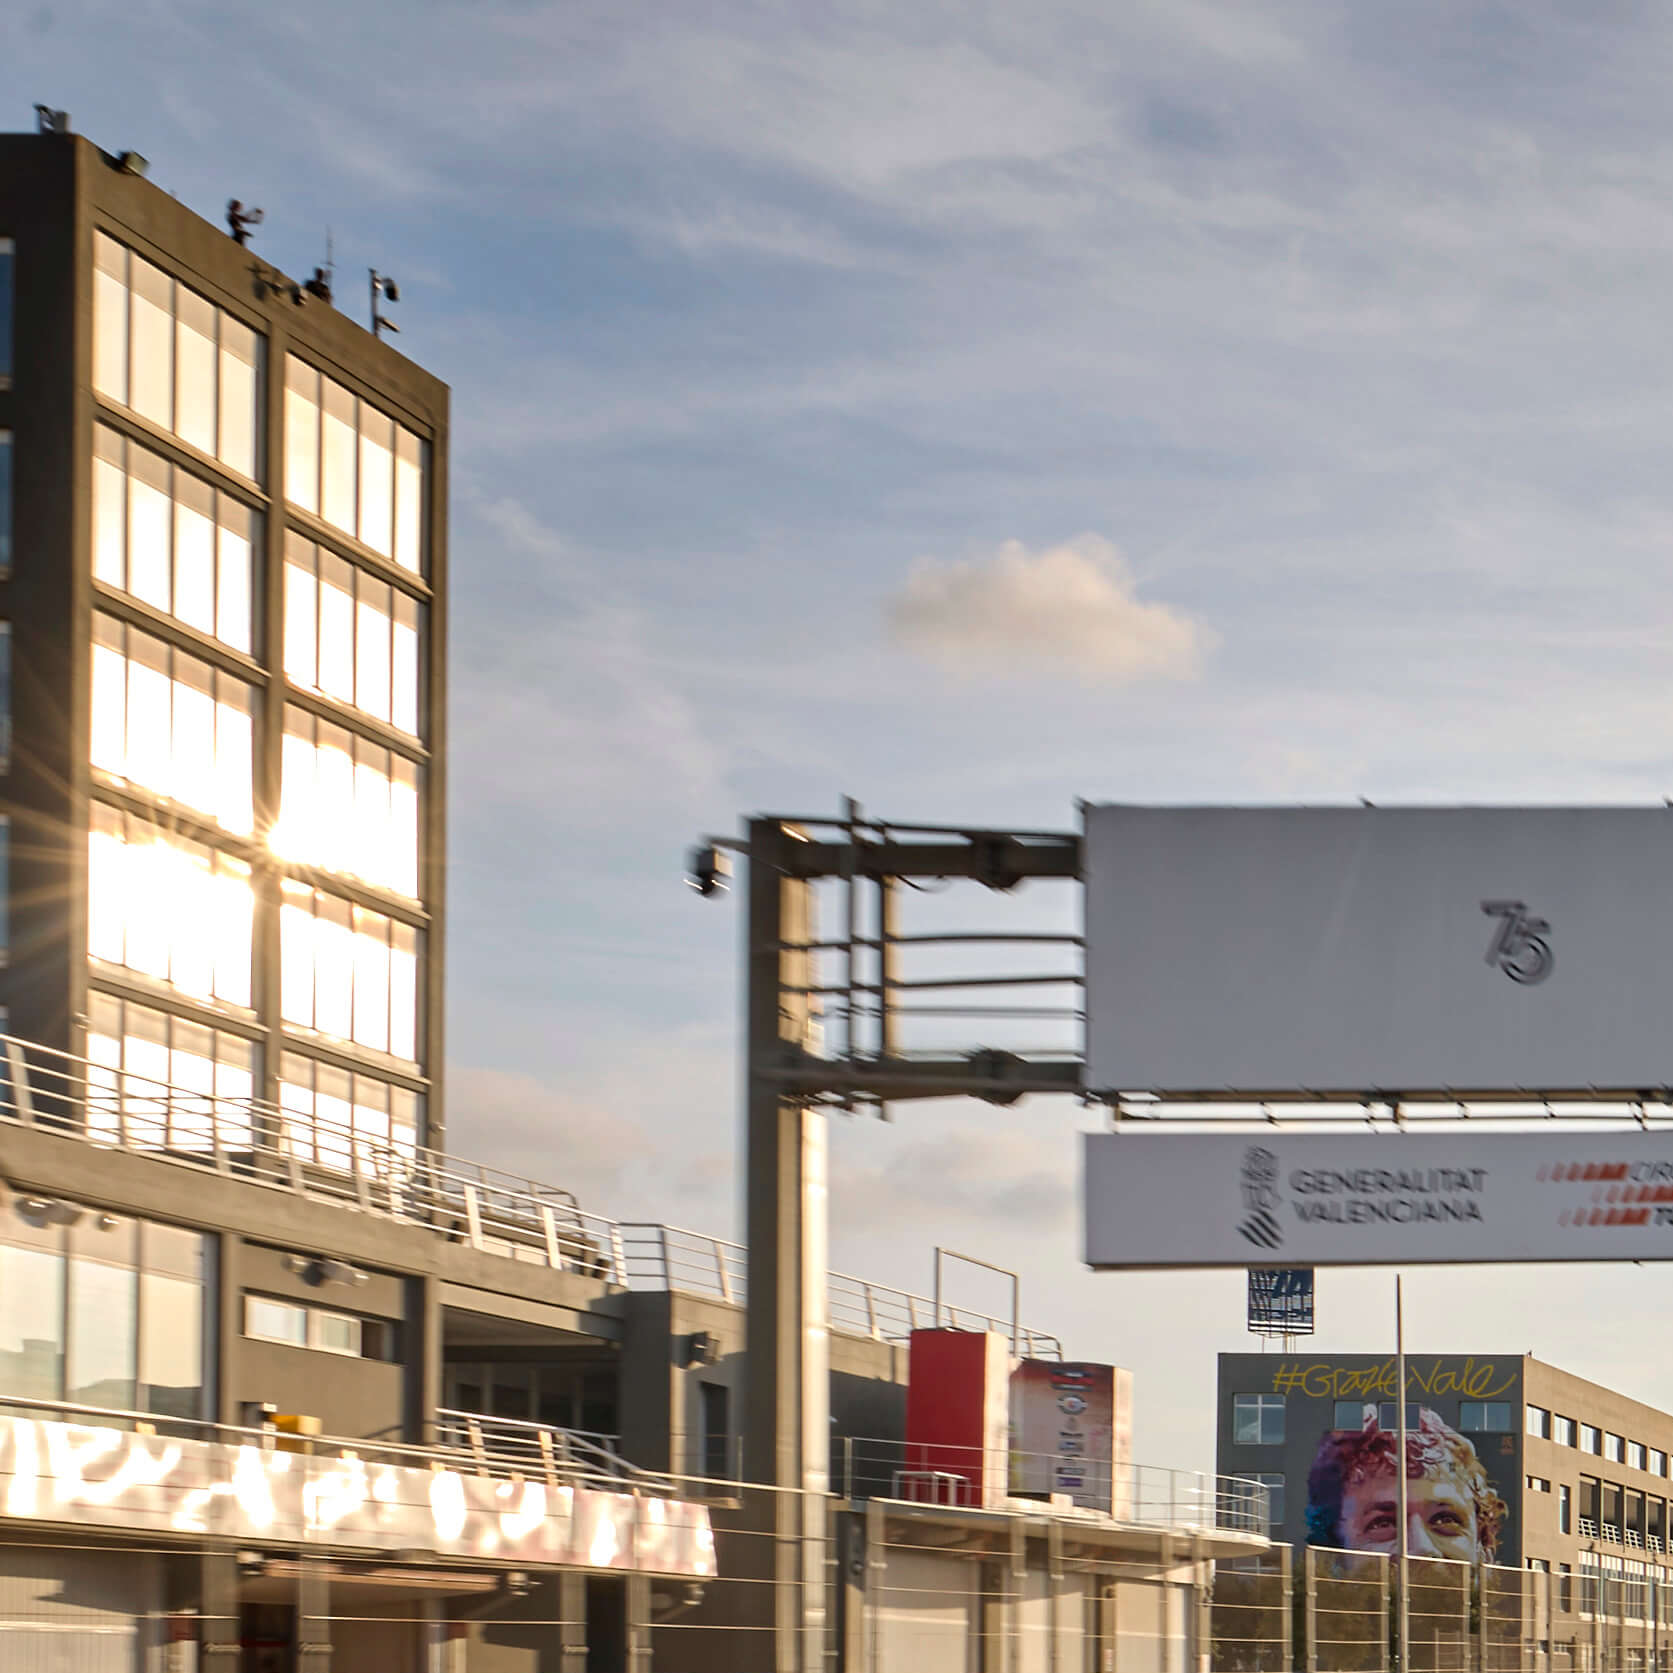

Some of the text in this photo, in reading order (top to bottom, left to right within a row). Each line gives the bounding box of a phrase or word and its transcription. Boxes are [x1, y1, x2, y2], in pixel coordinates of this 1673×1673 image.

[1480, 899, 1554, 985] 75
[1288, 1168, 1488, 1194] GENERALITAT
[1291, 1199, 1484, 1224] VALENCIANA
